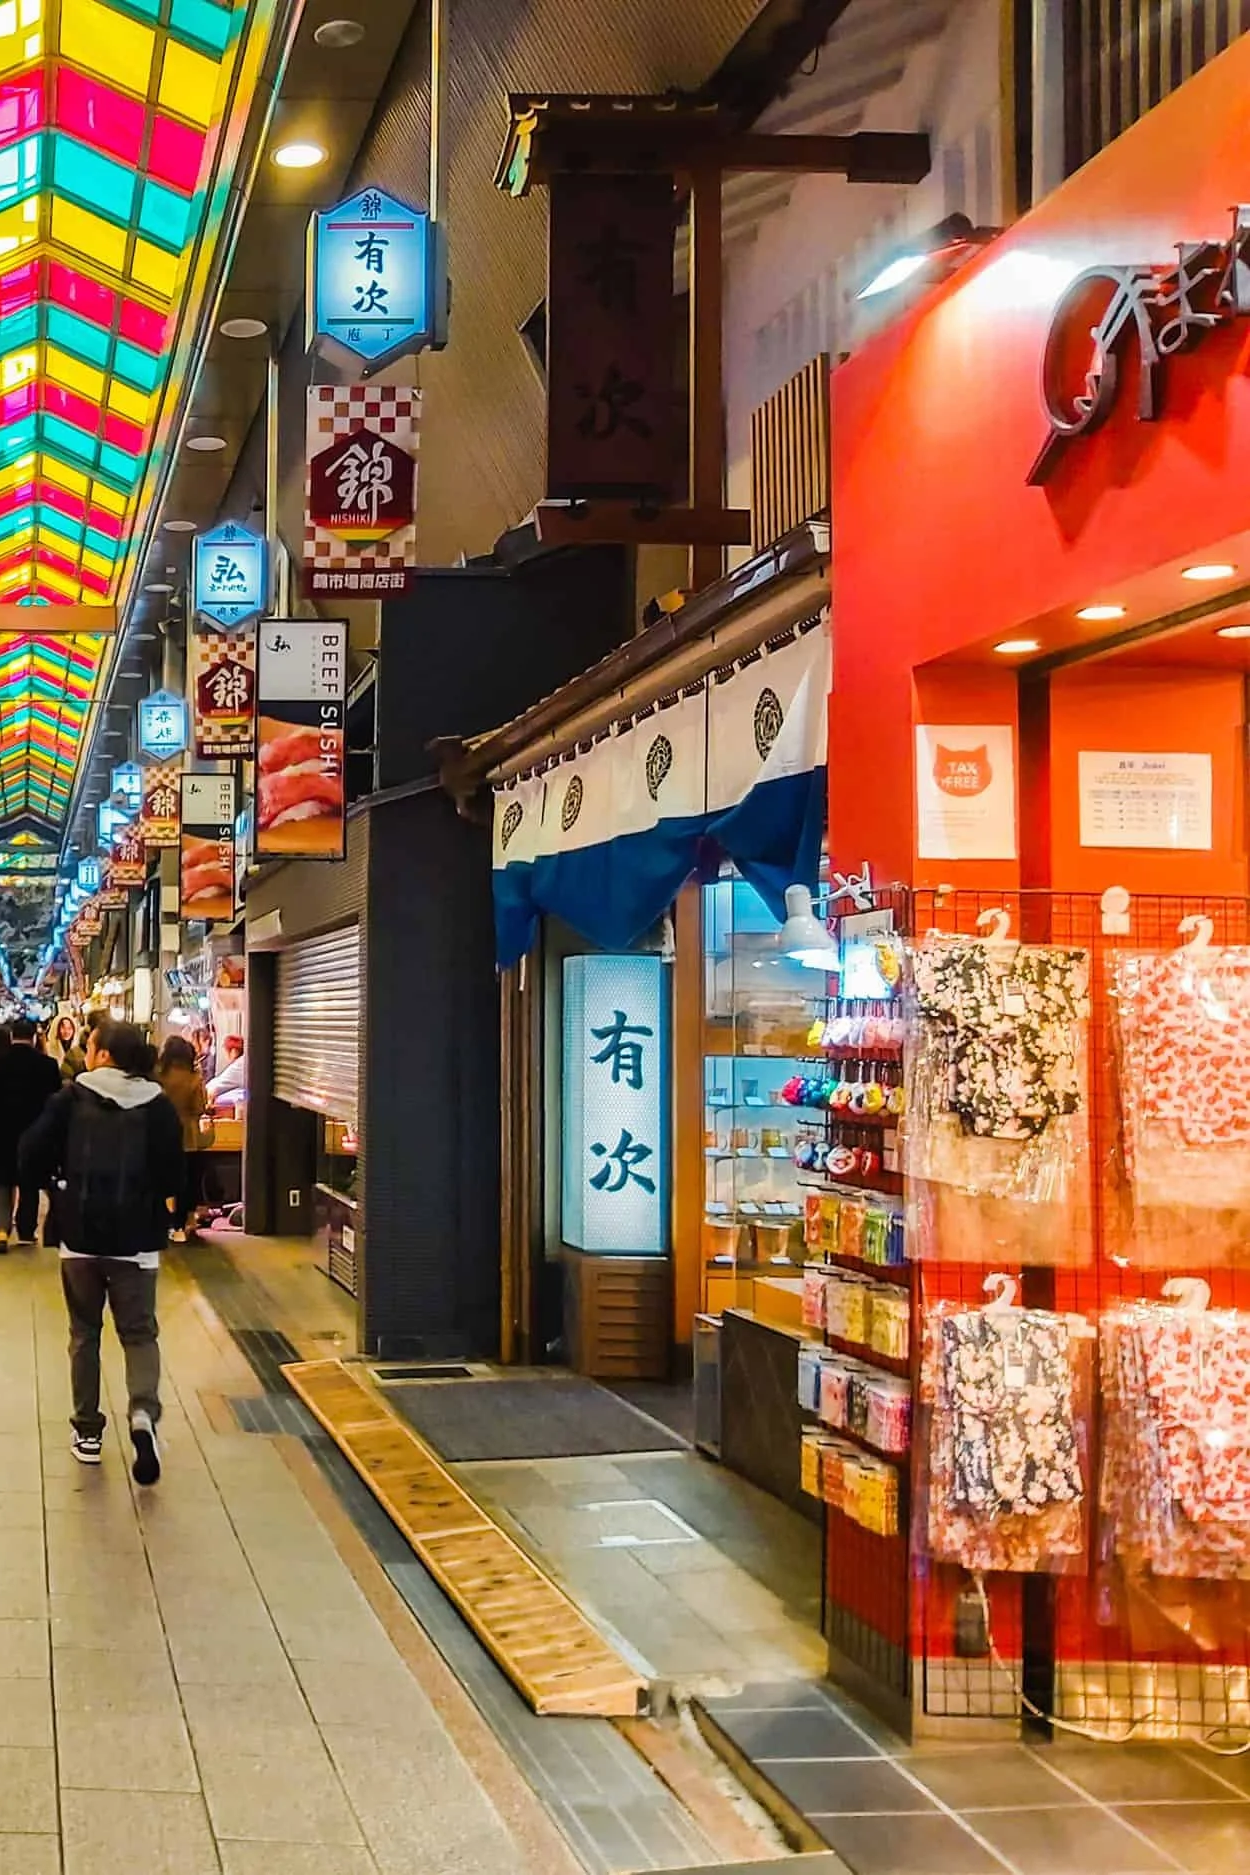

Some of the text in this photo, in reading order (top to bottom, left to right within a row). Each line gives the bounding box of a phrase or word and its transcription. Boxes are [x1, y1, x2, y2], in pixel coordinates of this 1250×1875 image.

[361, 193, 381, 219] 錦
[352, 231, 389, 314] 有次
[325, 441, 393, 527] 錦
[330, 513, 370, 525] NISHIKI
[321, 634, 339, 695] BEEF
[206, 666, 249, 716] 錦
[320, 705, 338, 778] SUSHI
[946, 776, 980, 789] FREE
[948, 760, 979, 776] TAX
[220, 783, 231, 822] BEEF
[589, 1009, 656, 1195] 有次
